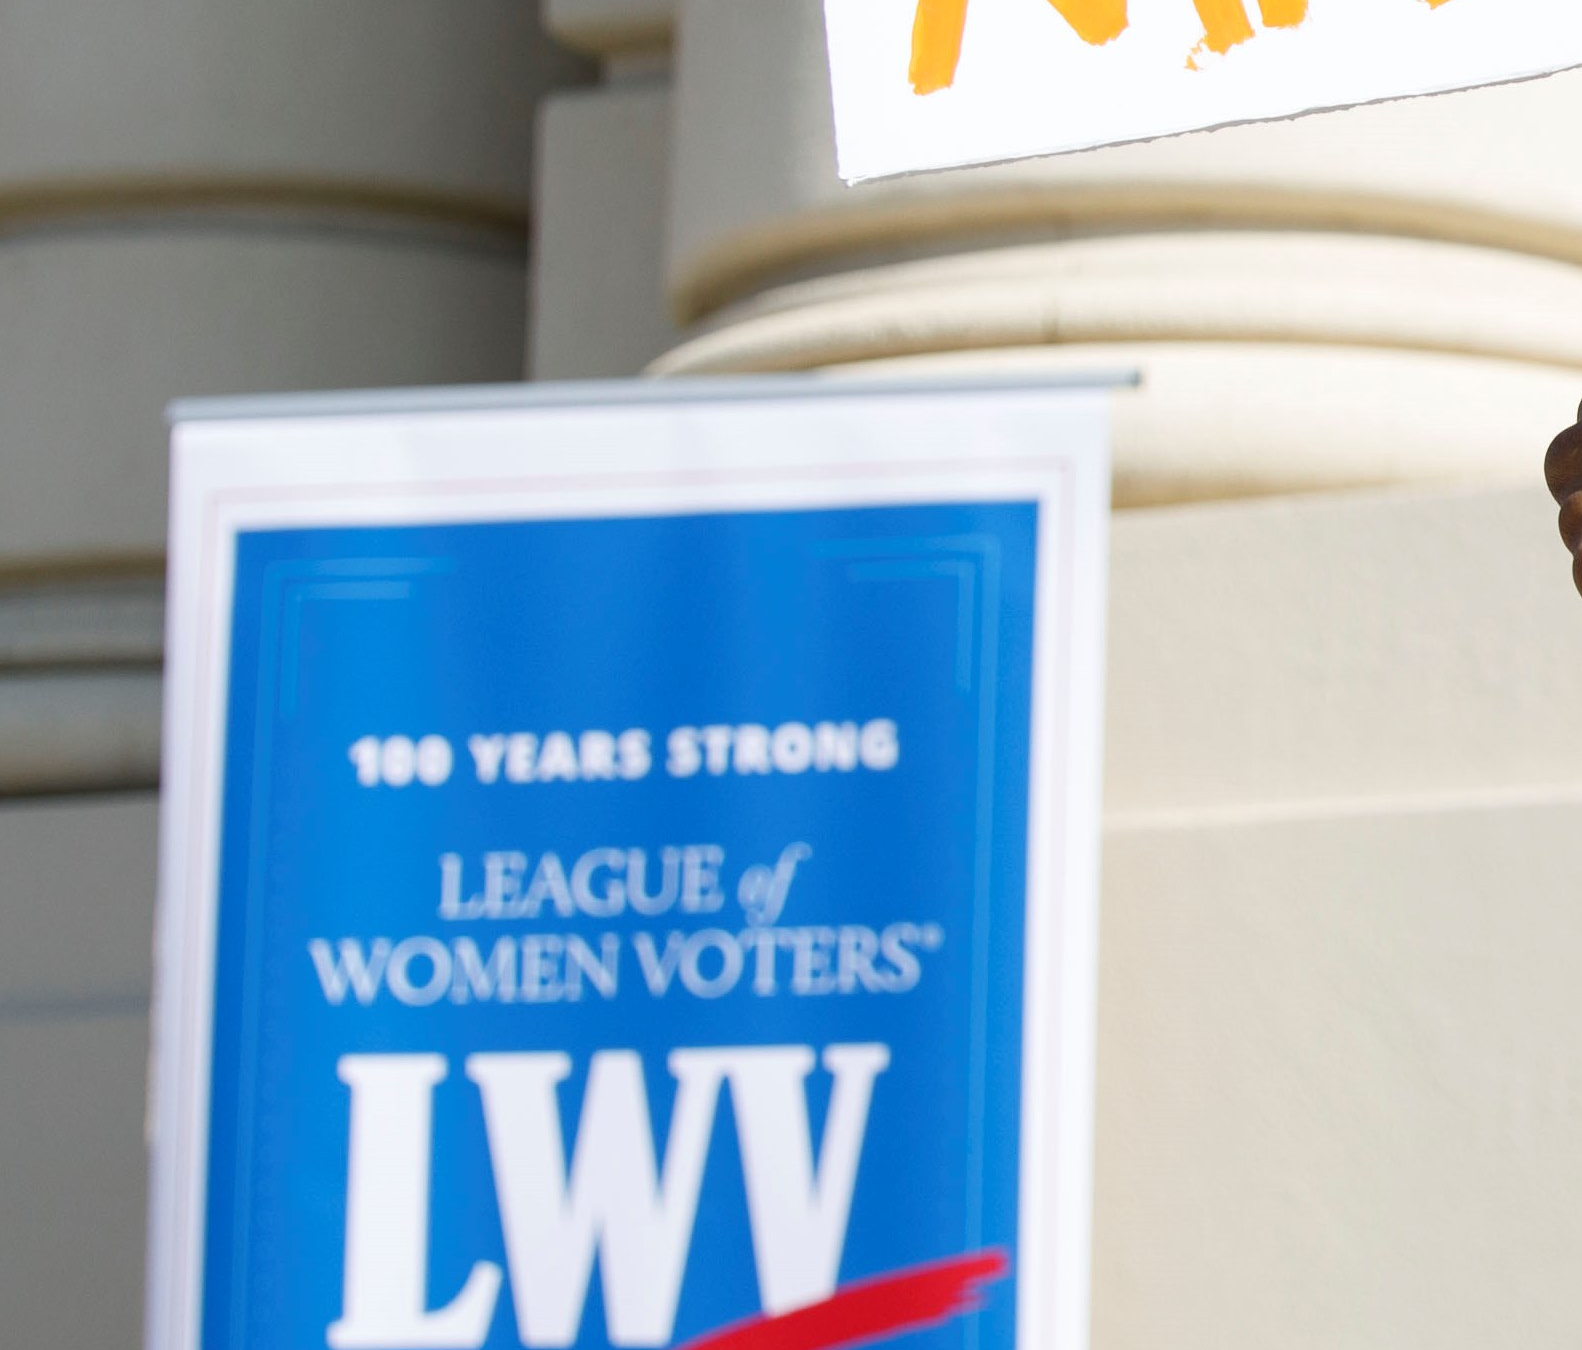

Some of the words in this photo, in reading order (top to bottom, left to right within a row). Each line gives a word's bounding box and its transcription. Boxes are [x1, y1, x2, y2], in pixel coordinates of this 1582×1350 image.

[347, 734, 454, 787] 100
[467, 728, 652, 785] YEARS
[666, 718, 900, 779] STRONG
[438, 844, 725, 920] LEAGUE
[737, 842, 812, 926] of
[308, 934, 619, 1007] WOMEN
